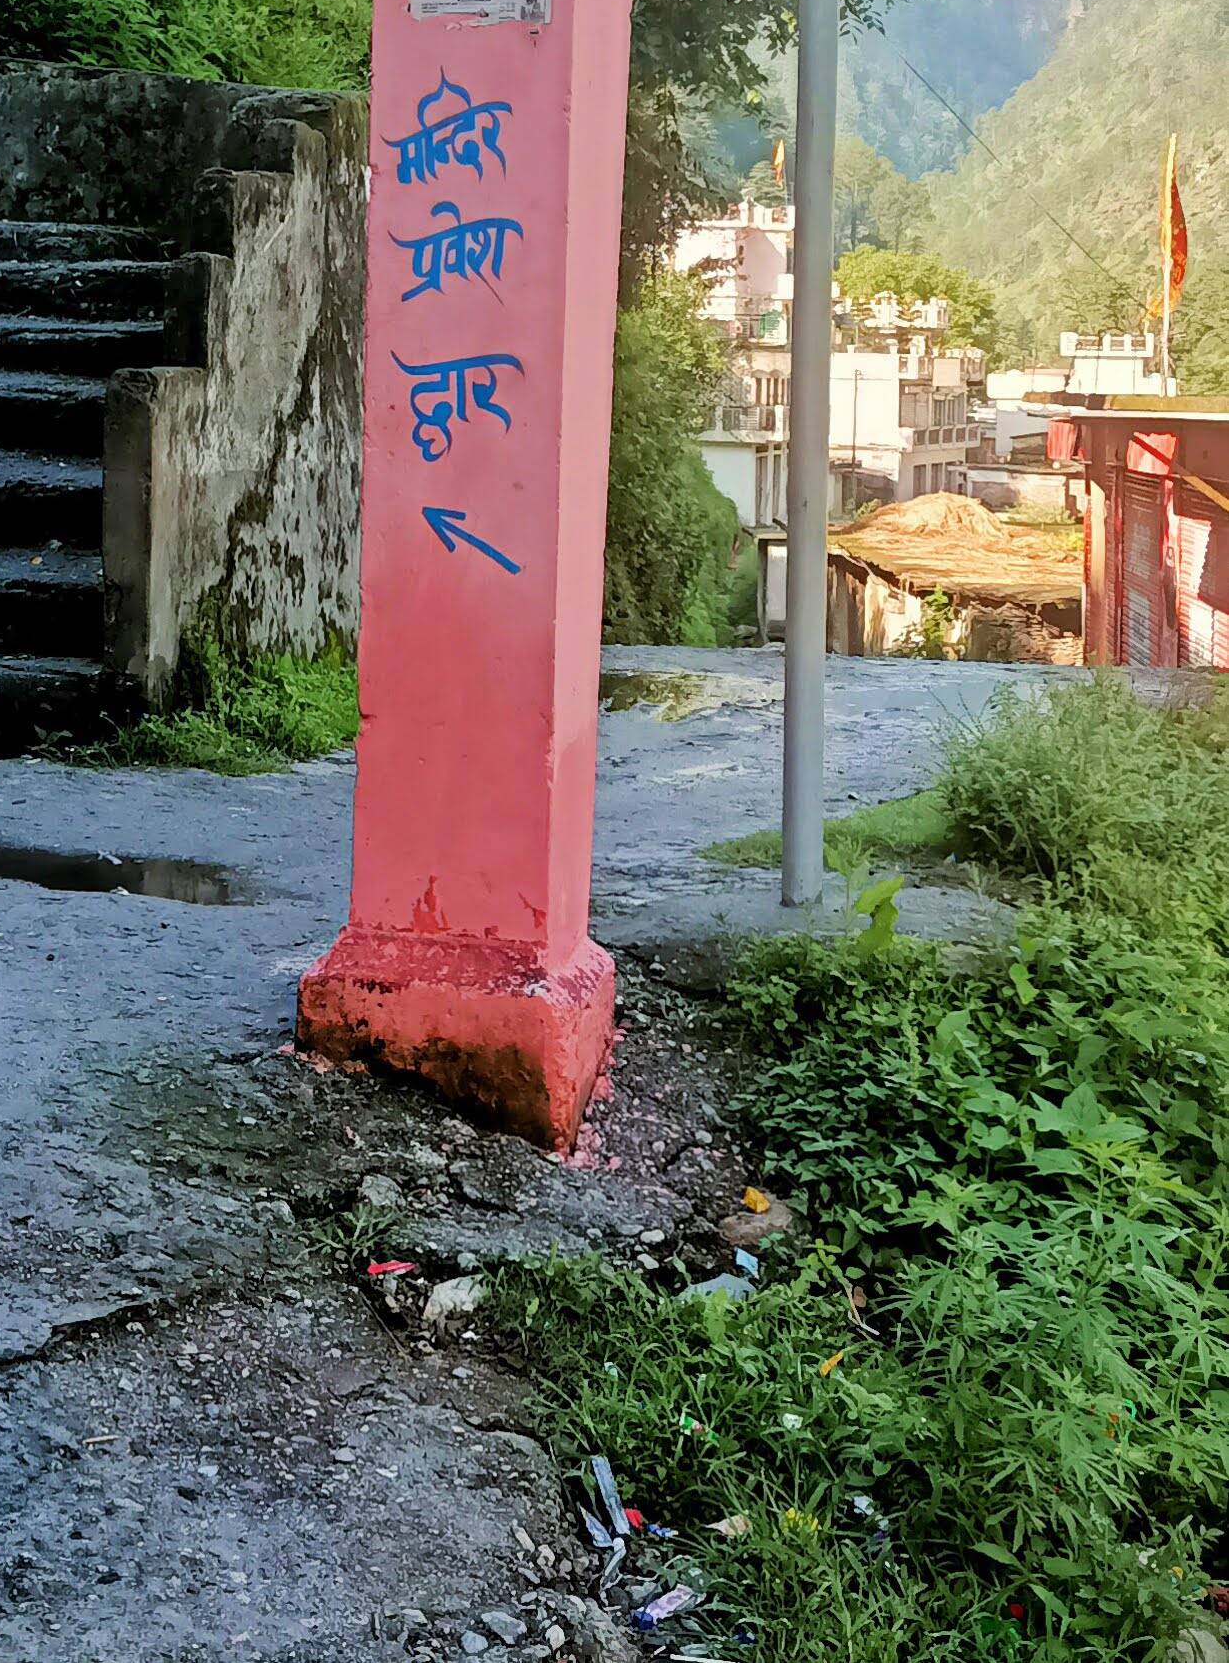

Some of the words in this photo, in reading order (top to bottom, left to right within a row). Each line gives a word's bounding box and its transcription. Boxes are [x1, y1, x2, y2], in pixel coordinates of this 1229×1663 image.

[379, 65, 514, 186] मन्दिर
[386, 201, 525, 306] प्रवेश
[391, 349, 525, 463] द्वार
